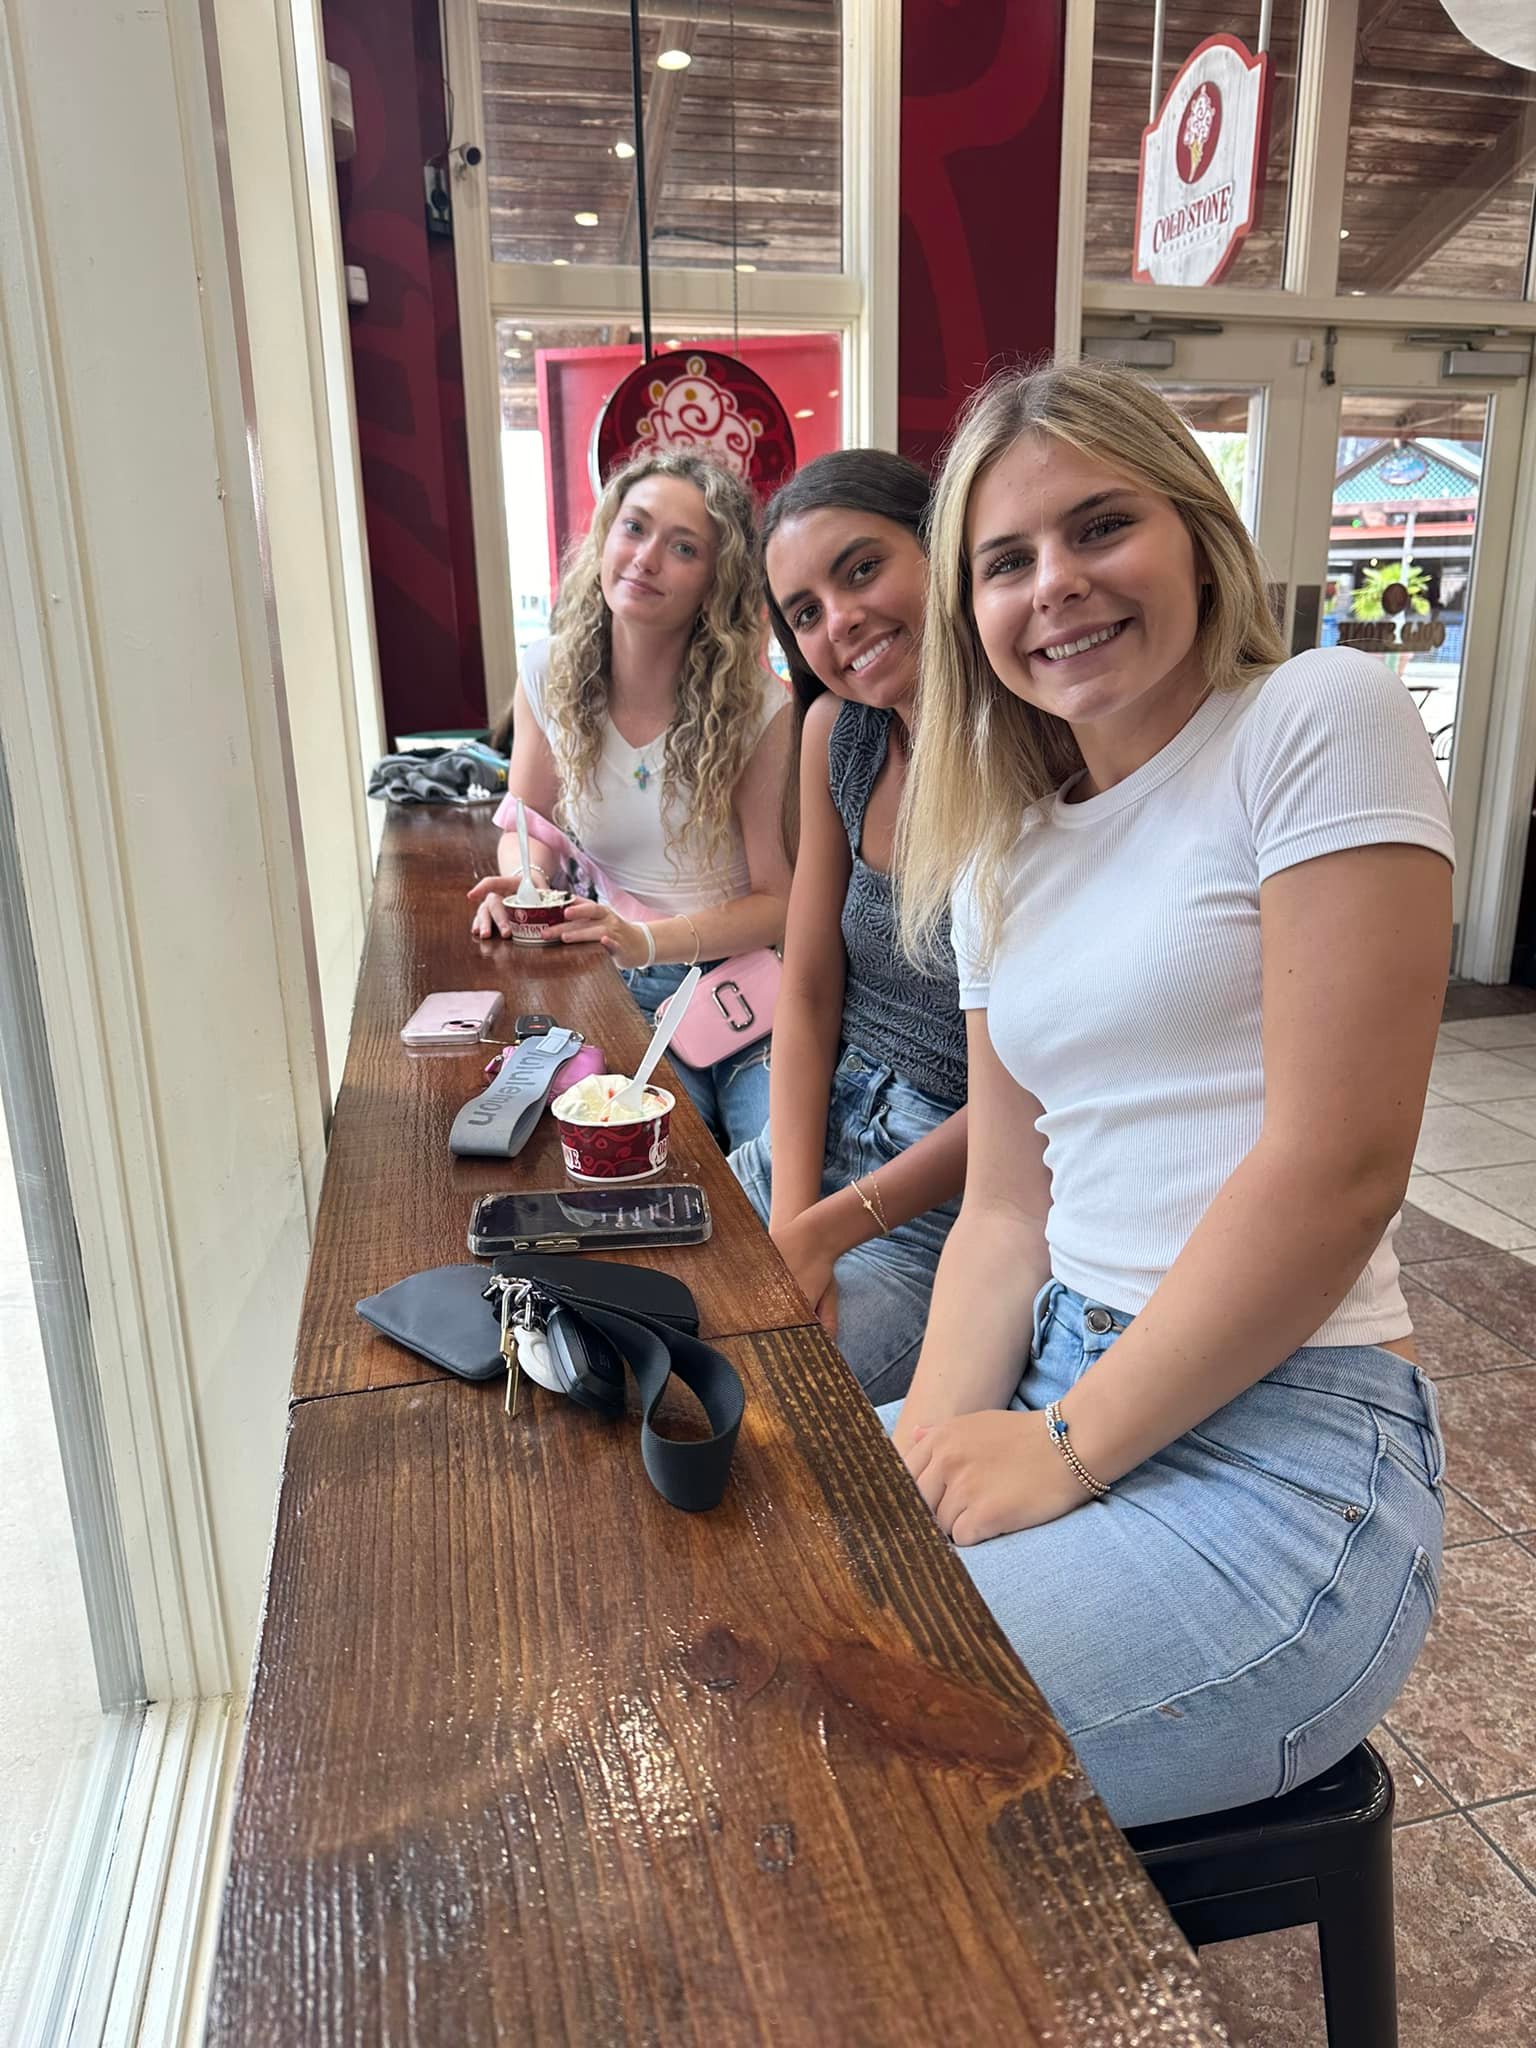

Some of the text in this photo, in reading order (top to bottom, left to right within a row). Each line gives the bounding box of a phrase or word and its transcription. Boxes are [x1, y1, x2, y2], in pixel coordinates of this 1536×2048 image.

[1153, 208, 1185, 254] COLD
[1187, 185, 1231, 233] STONE
[467, 1051, 549, 1126] lululemon
